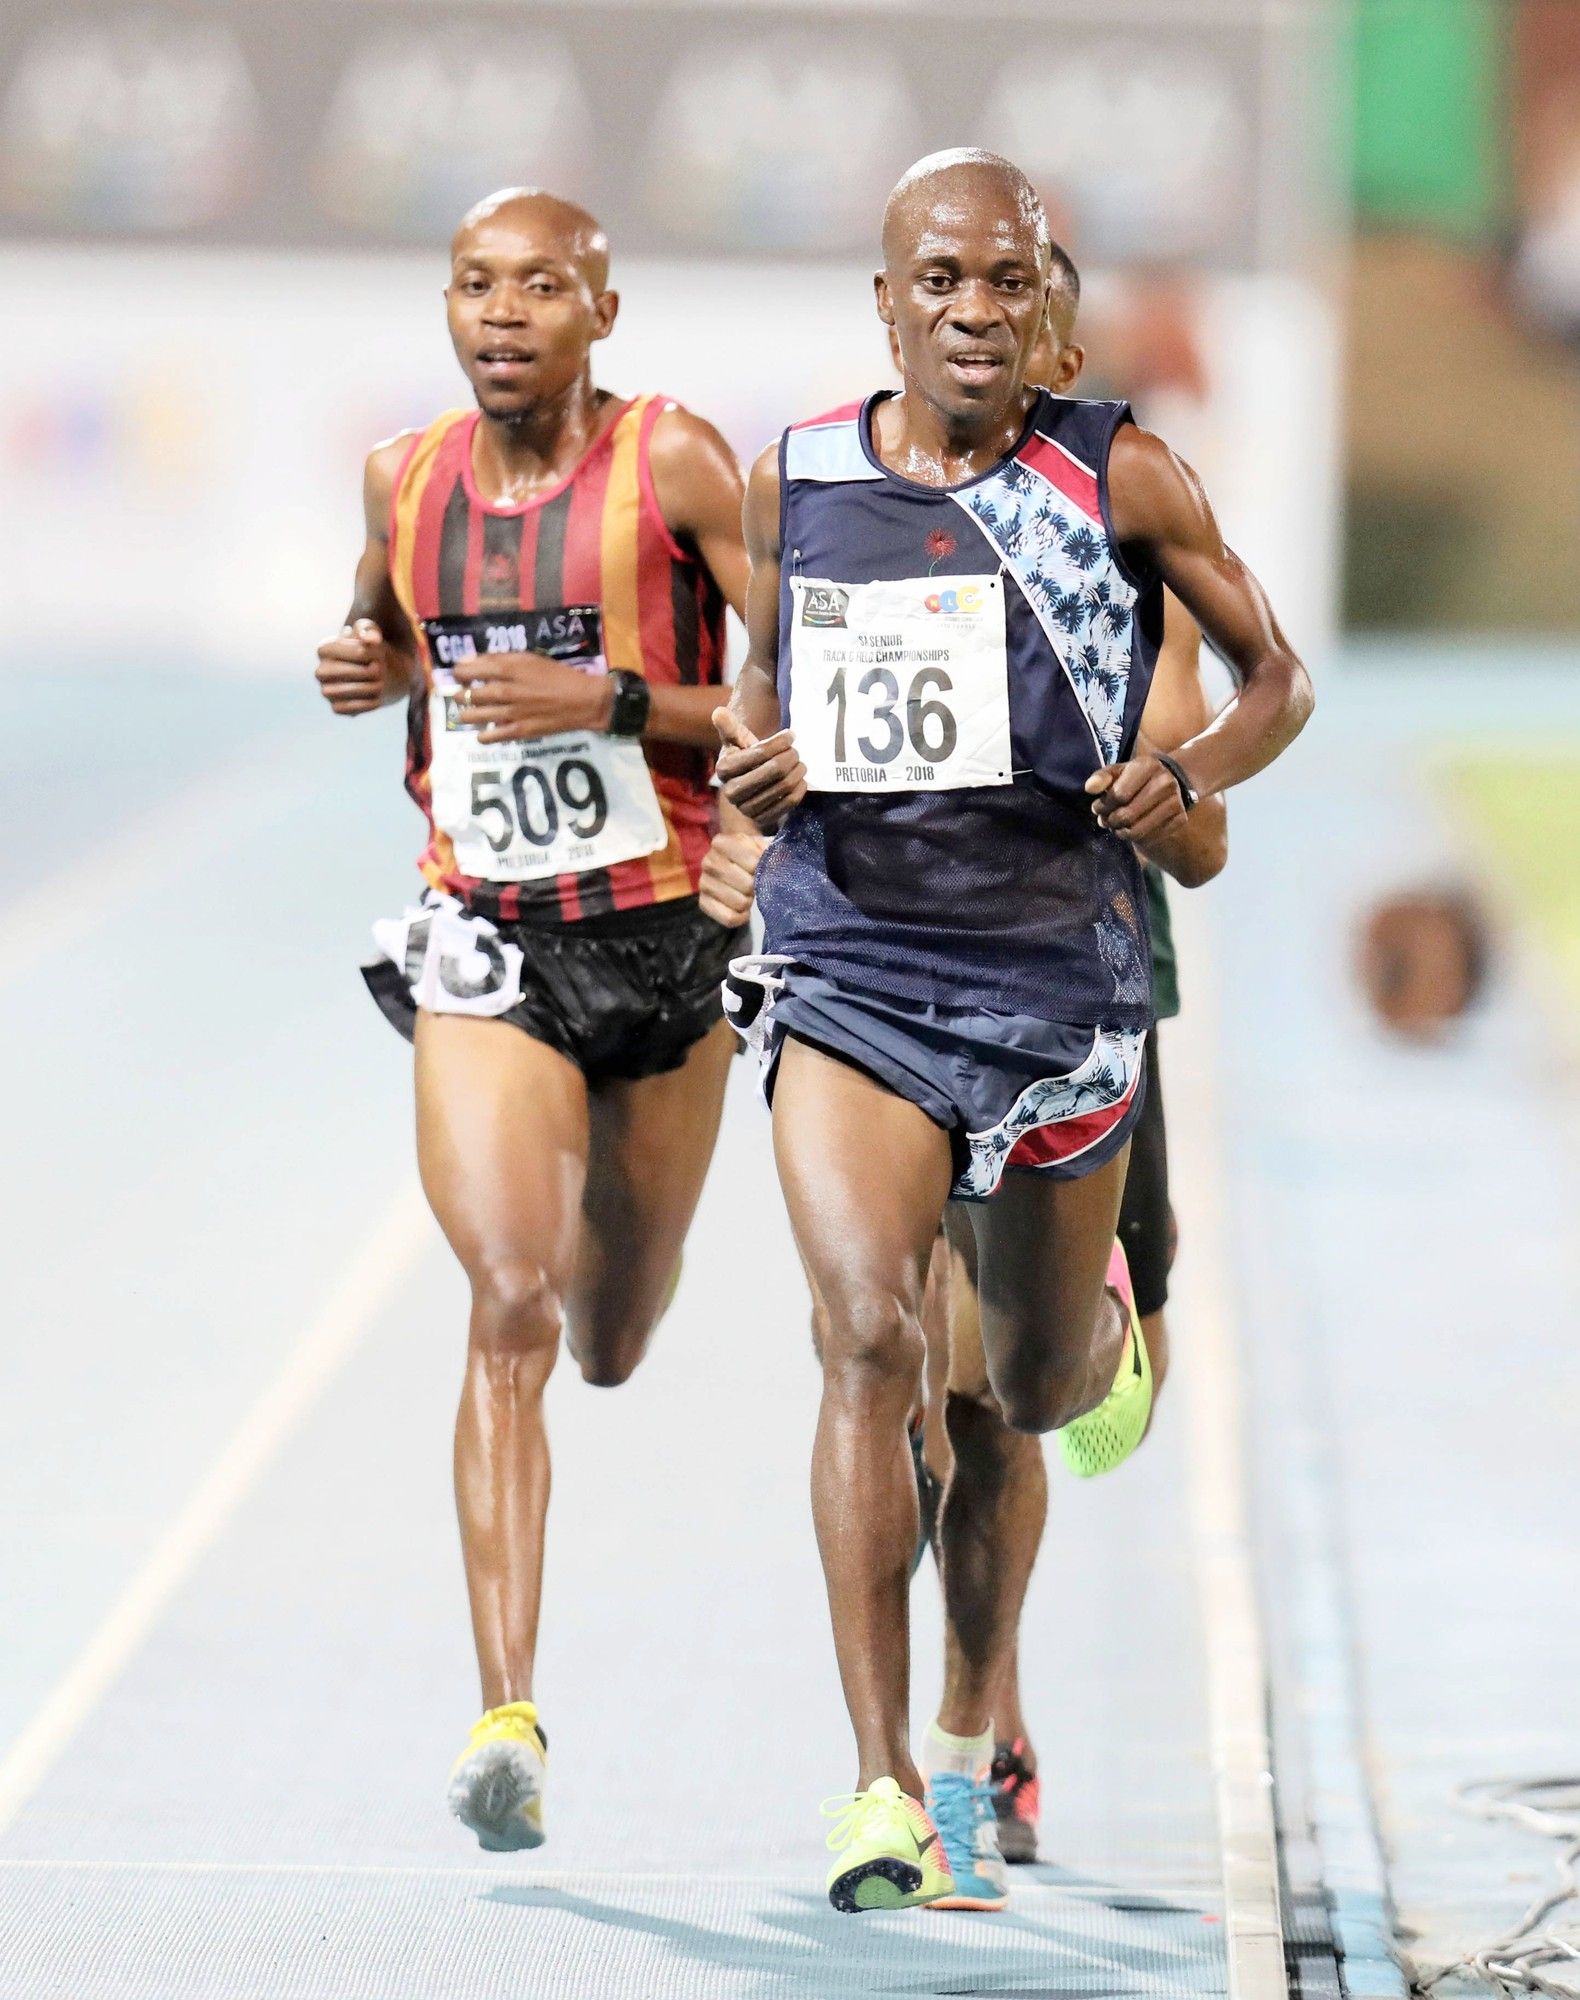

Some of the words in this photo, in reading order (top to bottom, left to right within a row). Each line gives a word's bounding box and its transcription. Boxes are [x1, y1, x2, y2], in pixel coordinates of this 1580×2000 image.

[808, 591, 840, 611] ASA
[536, 615, 586, 640] ASA
[870, 634, 903, 647] SENIOR
[823, 649, 846, 662] TRACK
[875, 649, 950, 663] CHAMPIONSHIPS
[827, 667, 957, 764] 136
[836, 767, 887, 783] PRETORIA
[906, 766, 935, 781] 2018
[471, 759, 608, 853] 509
